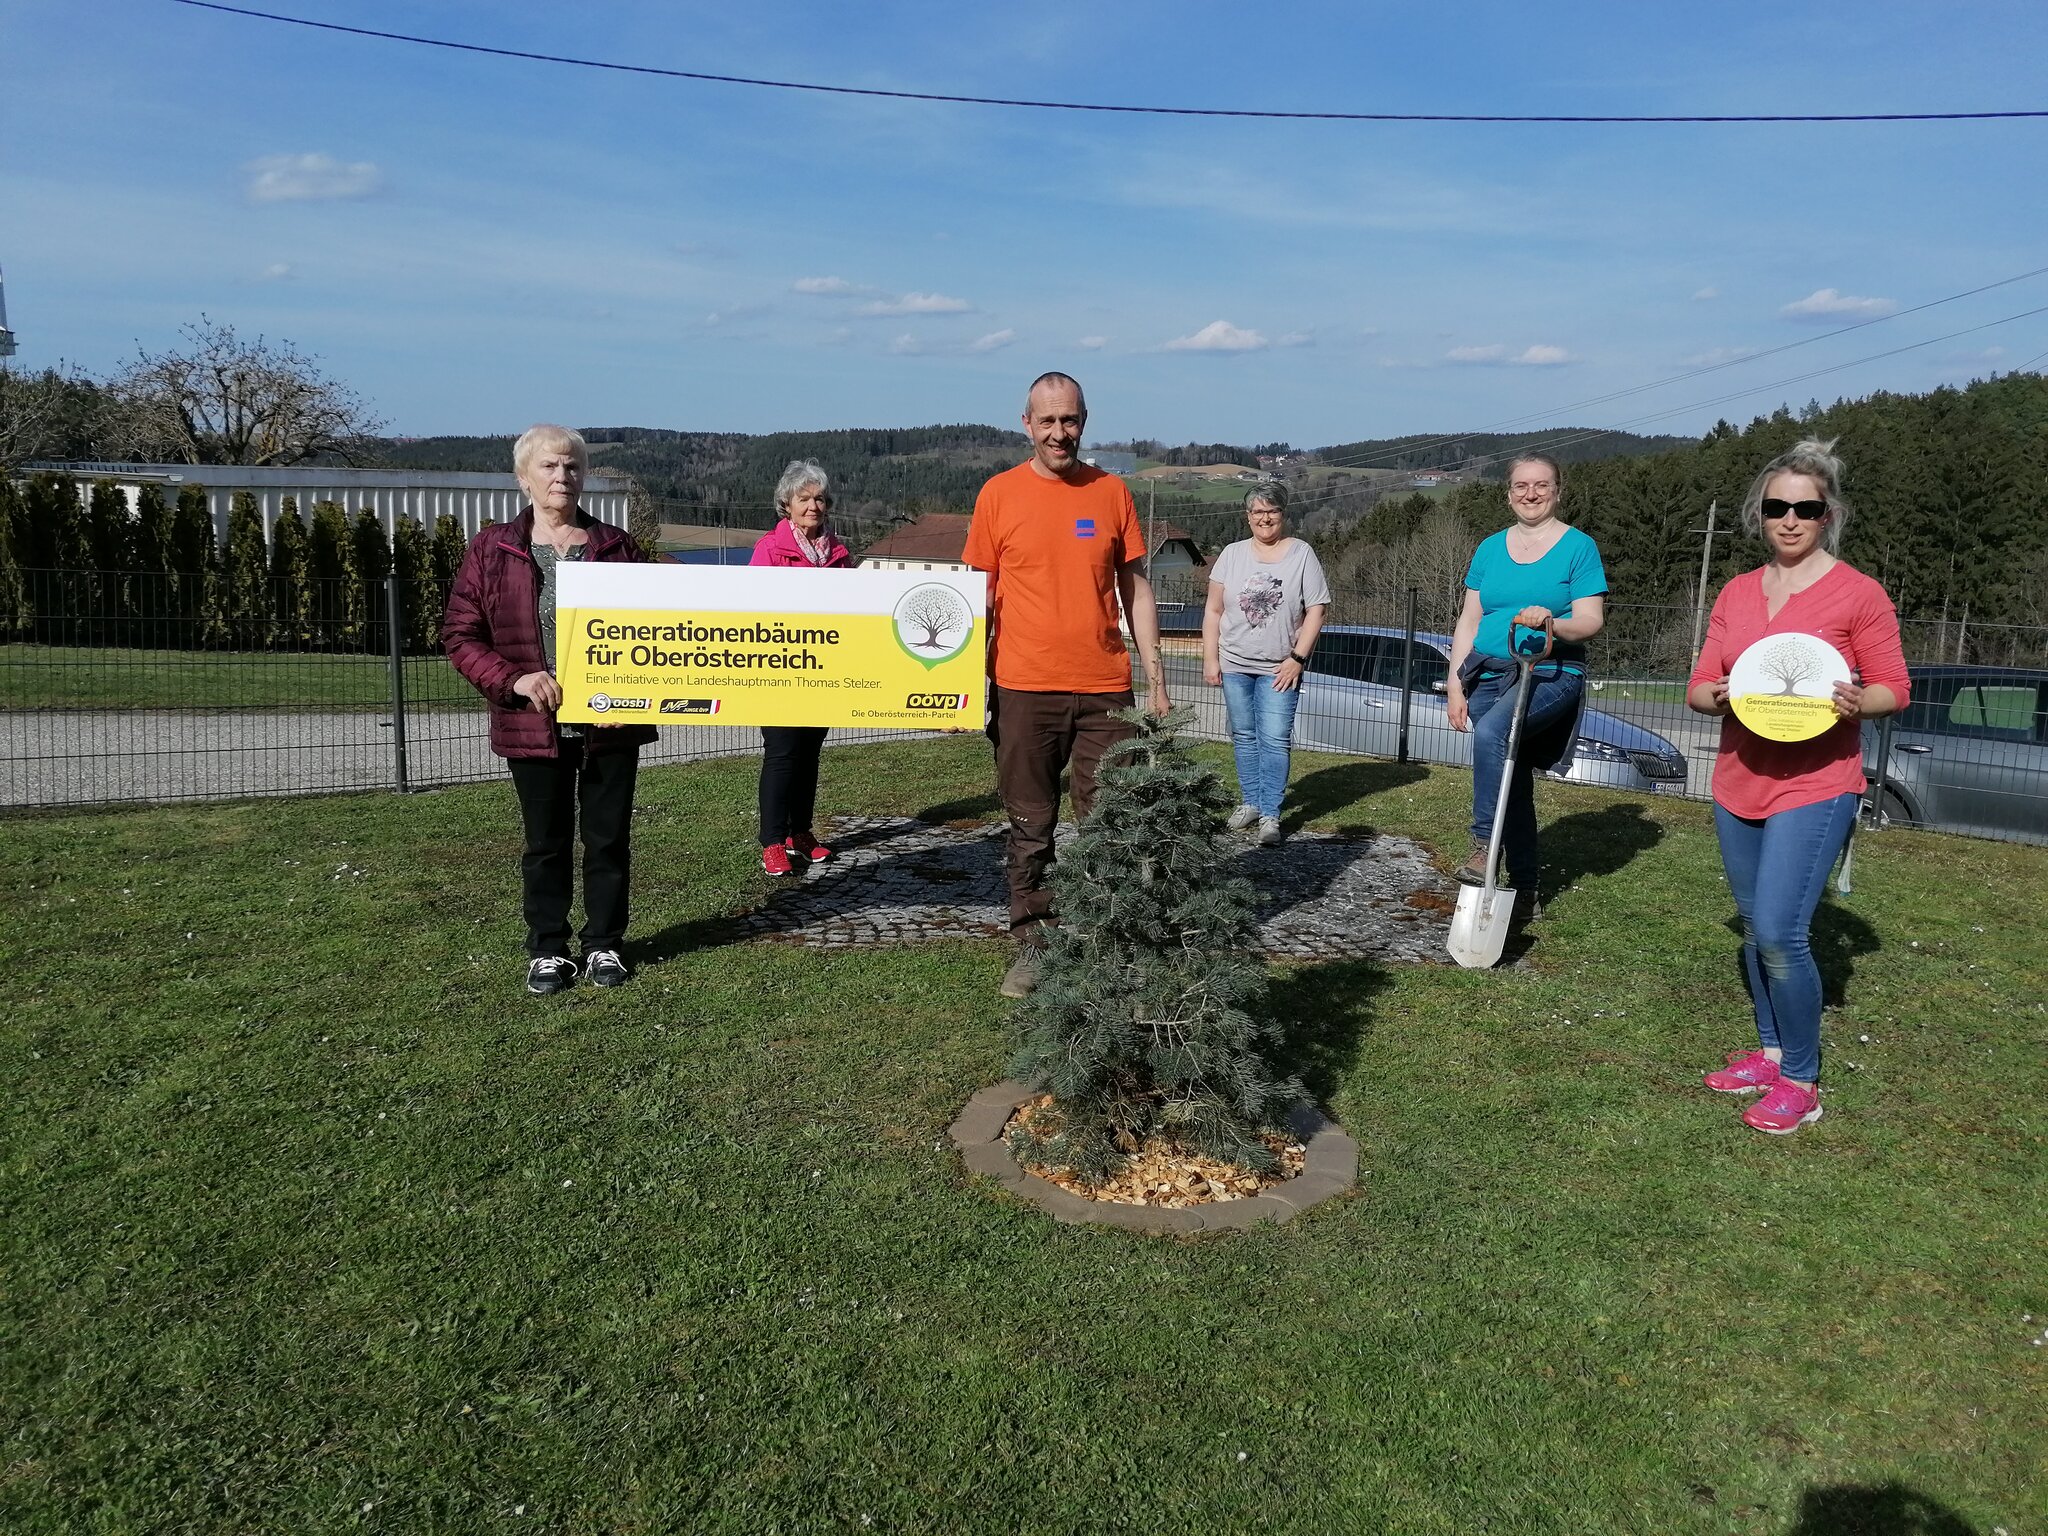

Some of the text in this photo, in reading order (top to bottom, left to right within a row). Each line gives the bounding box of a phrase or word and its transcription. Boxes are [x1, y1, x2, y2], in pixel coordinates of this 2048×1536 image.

[586, 618, 840, 645] Generationenbäume
[585, 644, 824, 670] für Oberösterreich.
[586, 673, 883, 689] Eine Initiative von Landeshauptmann Thomas Stelzer.
[908, 693, 958, 710] oövp
[1746, 697, 1833, 710] Generationenbäume
[851, 709, 957, 719] Die Oberösterreich-Partei
[1745, 705, 1818, 718] für Oberösterreich
